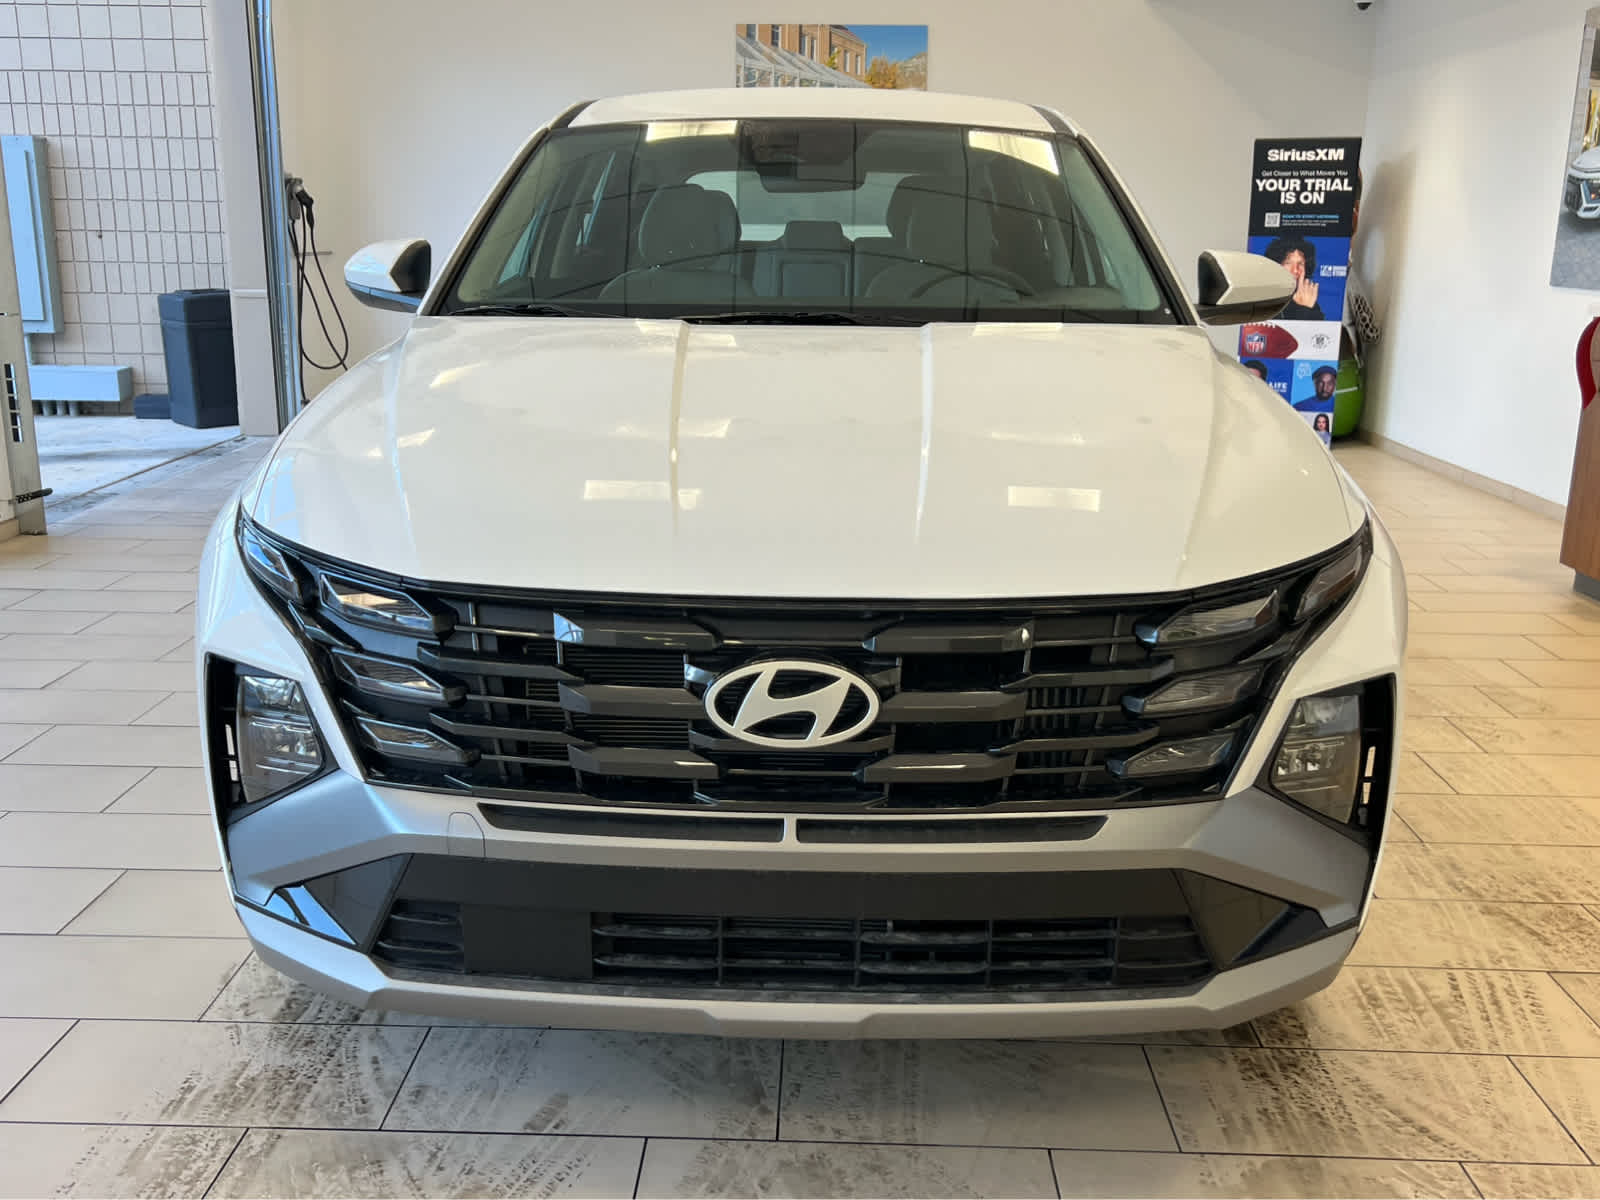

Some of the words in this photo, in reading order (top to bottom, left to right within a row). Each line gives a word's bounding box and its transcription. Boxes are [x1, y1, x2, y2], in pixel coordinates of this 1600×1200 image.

[1267, 148, 1345, 162] SiriusXM
[1300, 169, 1315, 177] What
[1316, 169, 1336, 177] Moves
[1336, 169, 1348, 177] You
[1256, 178, 1301, 192] YOUR
[1304, 178, 1353, 192] TRIAL
[1280, 191, 1297, 205] IS
[1299, 191, 1325, 205] ON
